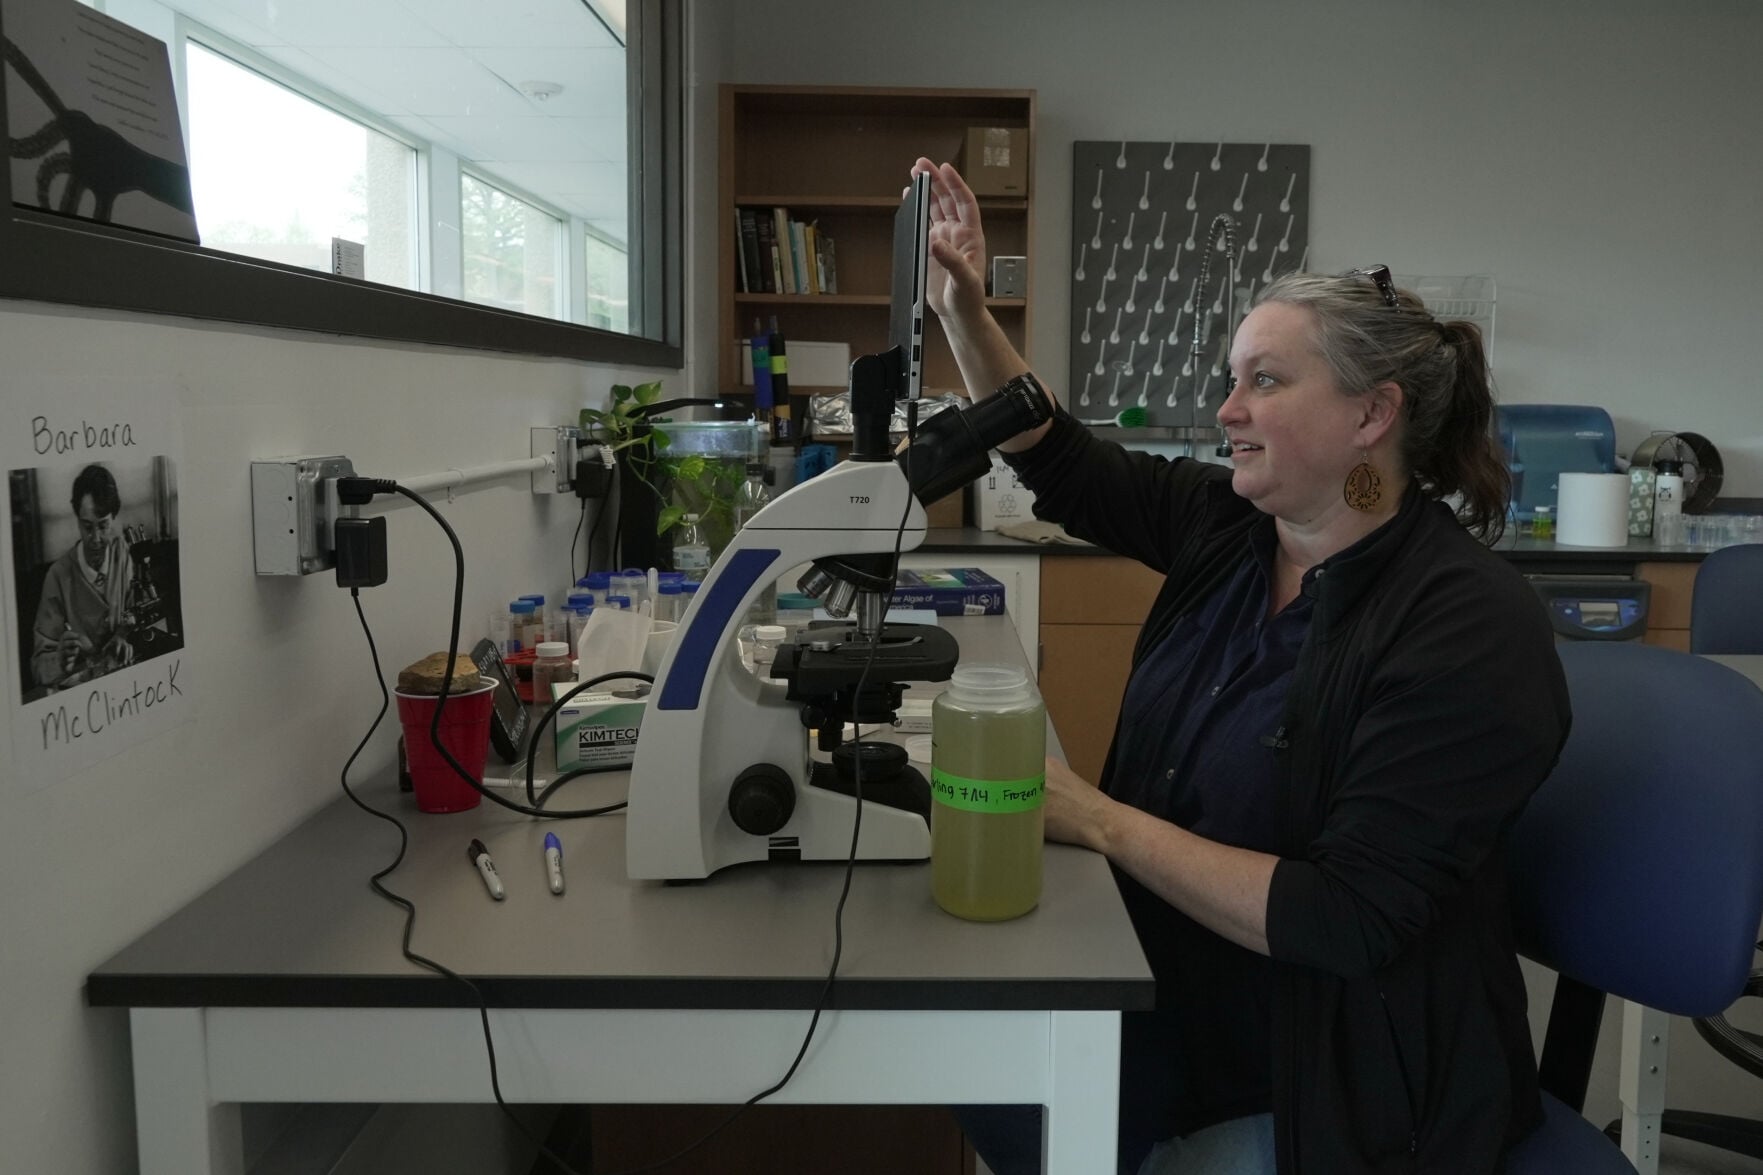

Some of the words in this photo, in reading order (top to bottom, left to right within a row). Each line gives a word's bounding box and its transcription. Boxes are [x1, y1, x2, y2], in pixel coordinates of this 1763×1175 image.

[31, 415, 137, 455] Barbara
[849, 496, 870, 504] T720
[903, 594, 924, 604] Algae
[925, 594, 934, 602] of
[1003, 787, 1037, 801] Frozen
